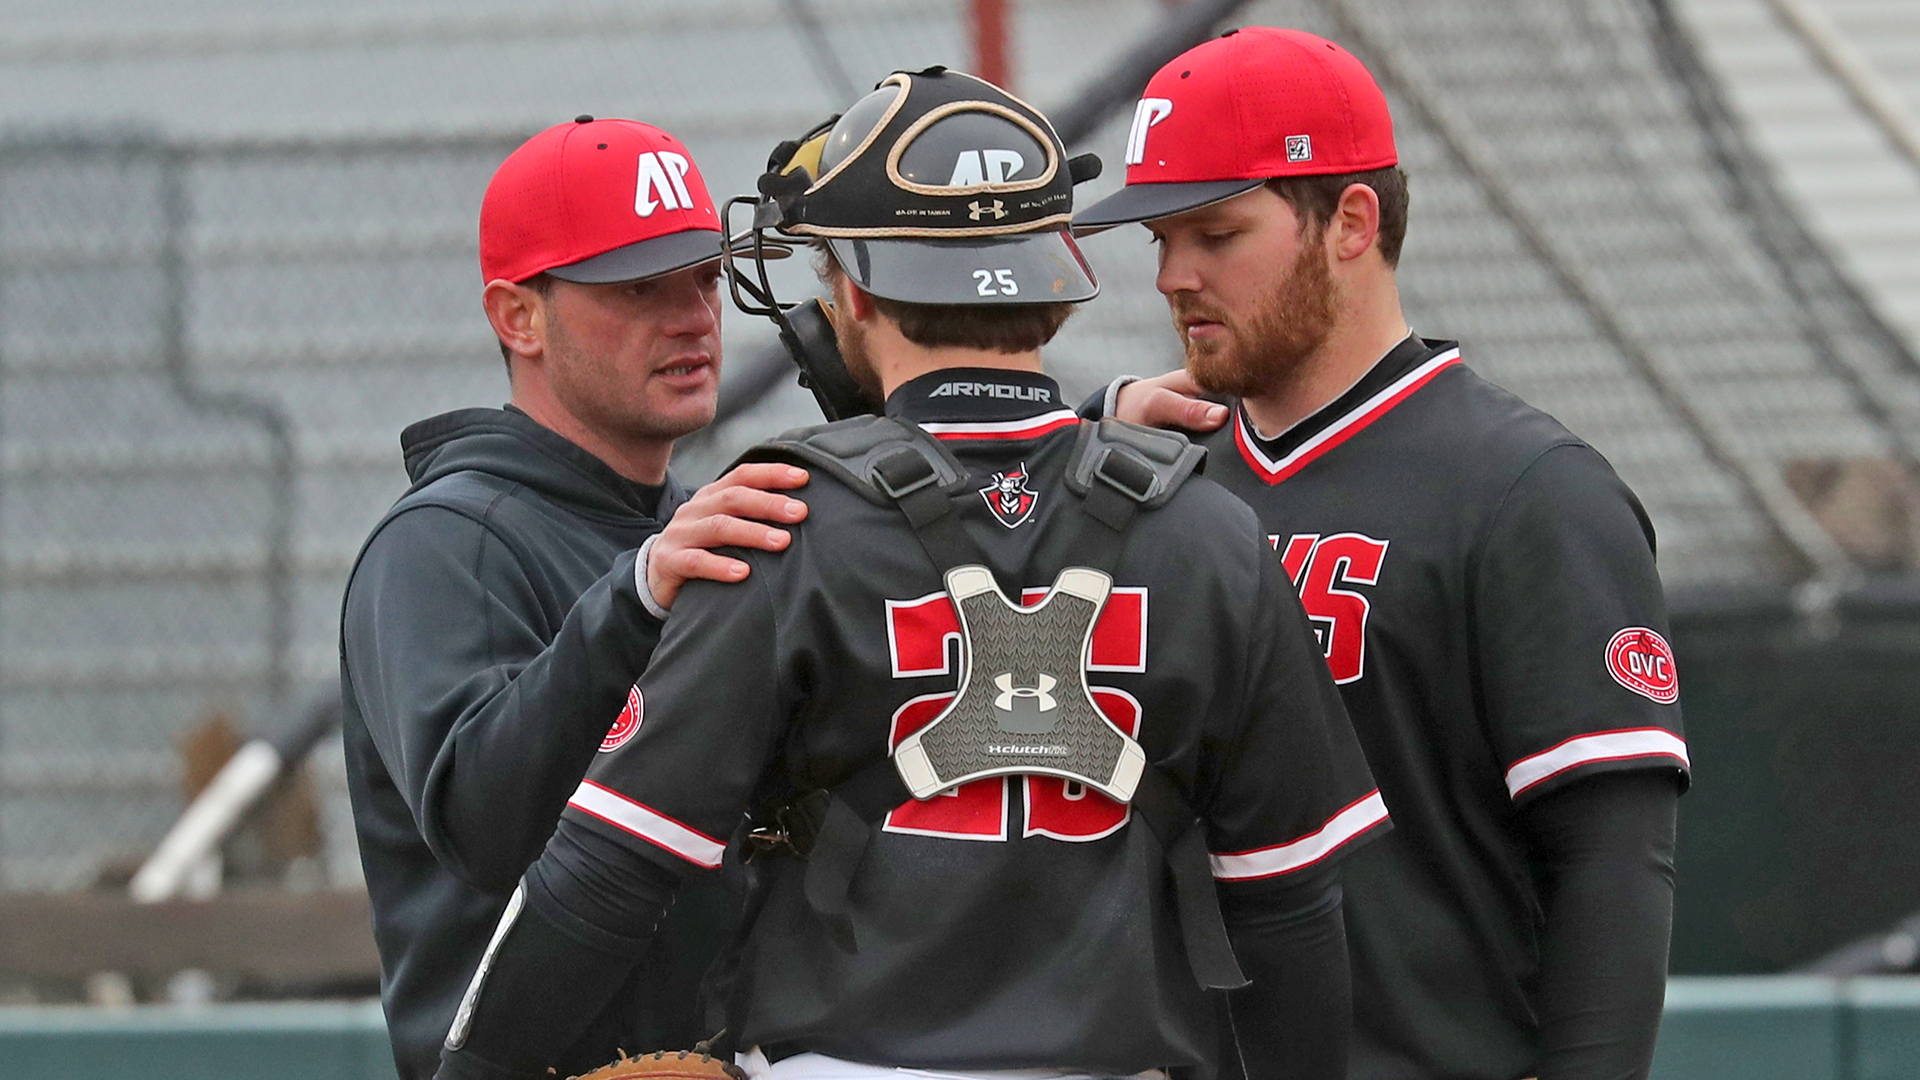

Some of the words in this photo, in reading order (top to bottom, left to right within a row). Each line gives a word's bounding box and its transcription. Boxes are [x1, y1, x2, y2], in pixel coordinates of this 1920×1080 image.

[634, 150, 694, 218] AP
[972, 269, 1019, 296] 25
[928, 382, 1051, 403] ARMOUR
[1628, 650, 1669, 682] OVC
